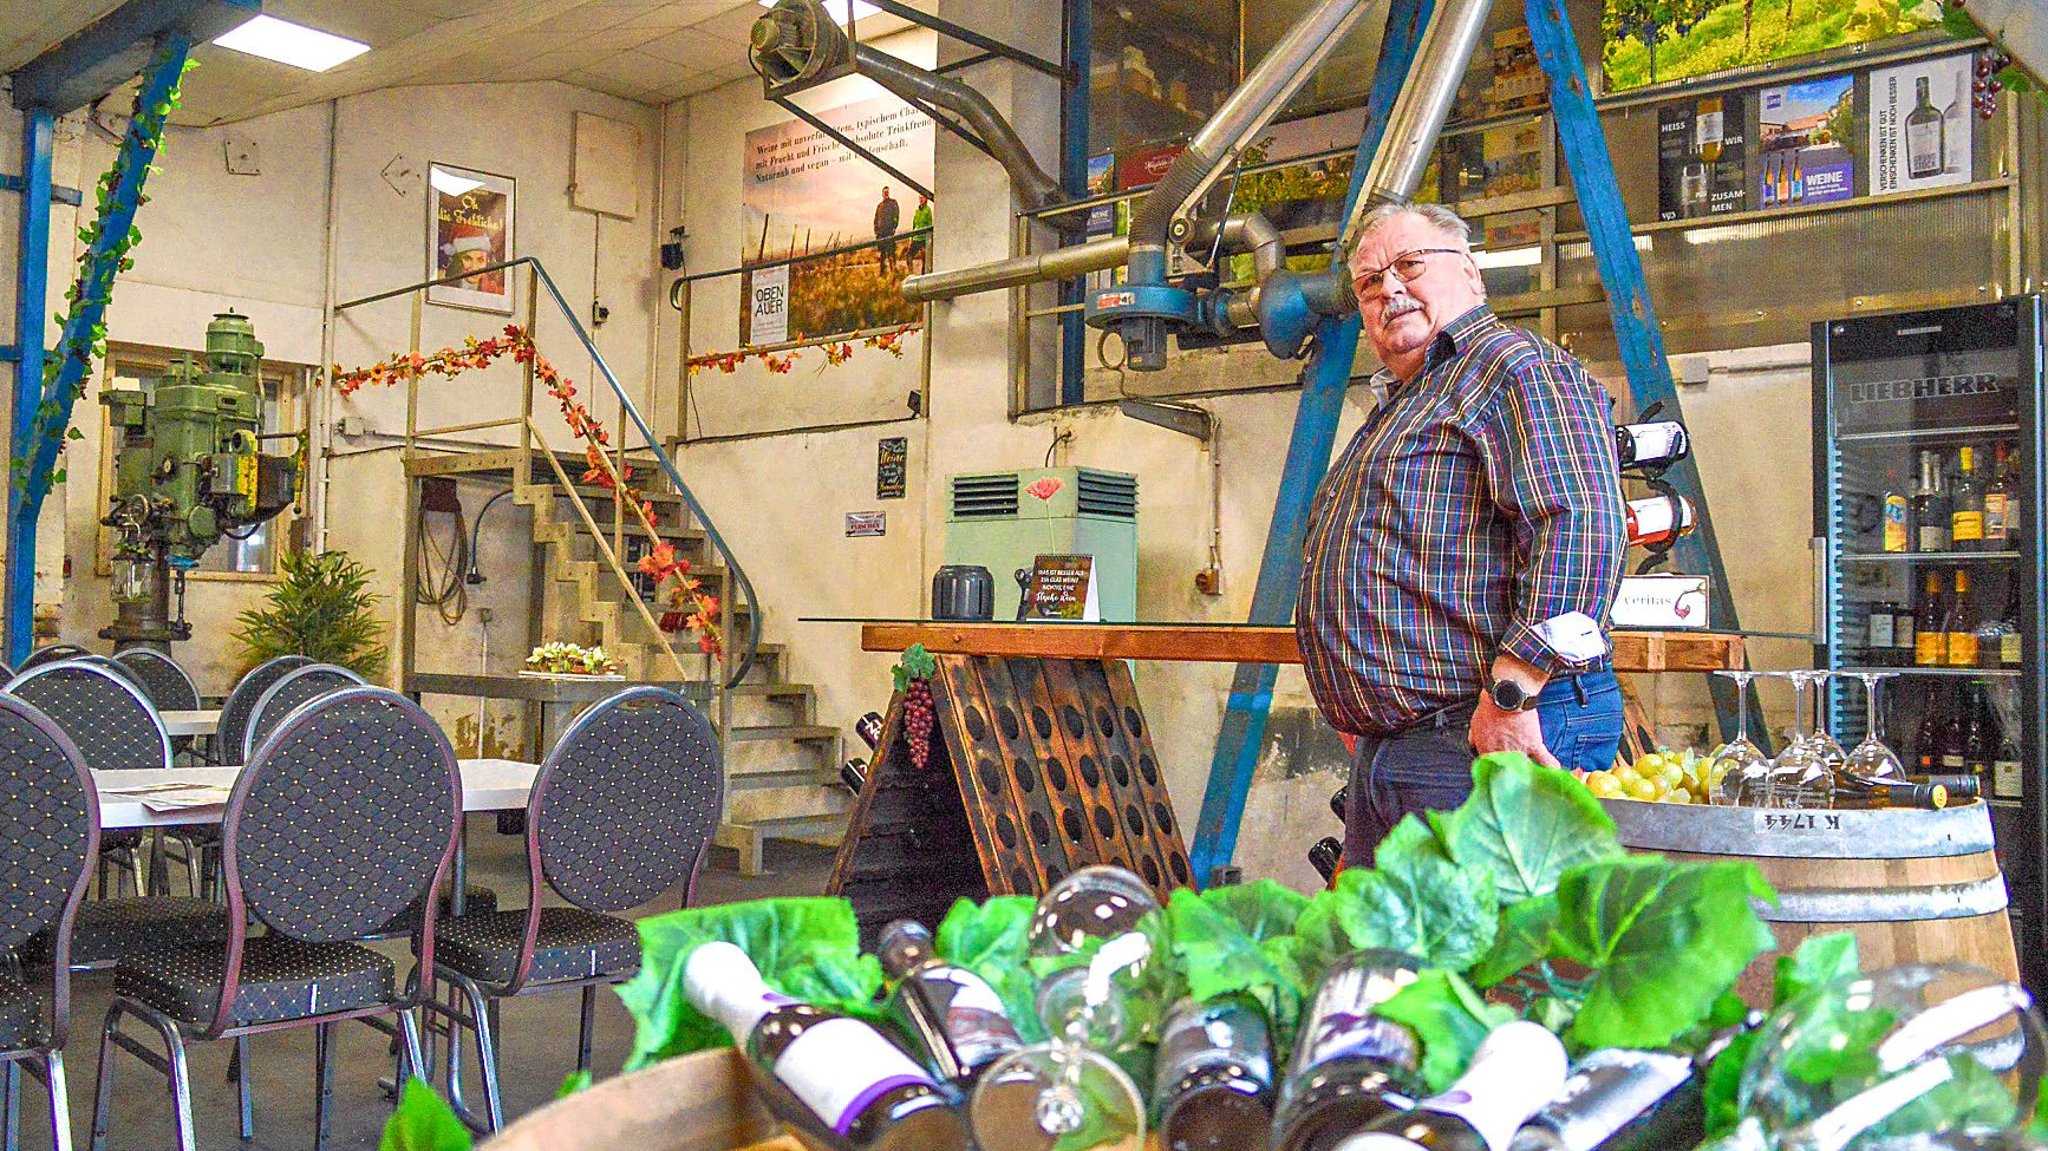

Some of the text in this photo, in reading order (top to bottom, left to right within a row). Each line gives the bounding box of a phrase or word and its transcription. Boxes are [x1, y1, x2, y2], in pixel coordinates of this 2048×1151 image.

[856, 112, 897, 131] typischem
[1661, 121, 1686, 133] HEISS
[1725, 136, 1743, 146] WIR
[1889, 76, 1897, 189] EINSCHENKEN IST NOCH BESSER
[796, 147, 810, 159] und
[1879, 110, 1888, 191] VERSCHENKEN IST GUT
[1806, 171, 1844, 186] WEINE
[1711, 189, 1746, 202] ZUSAM-
[1711, 202, 1733, 212] MEN
[755, 285, 784, 302] OBEN
[755, 300, 783, 317] AUER
[1850, 371, 2000, 403] LIEBHERR
[1764, 813, 1842, 831] K 1744
